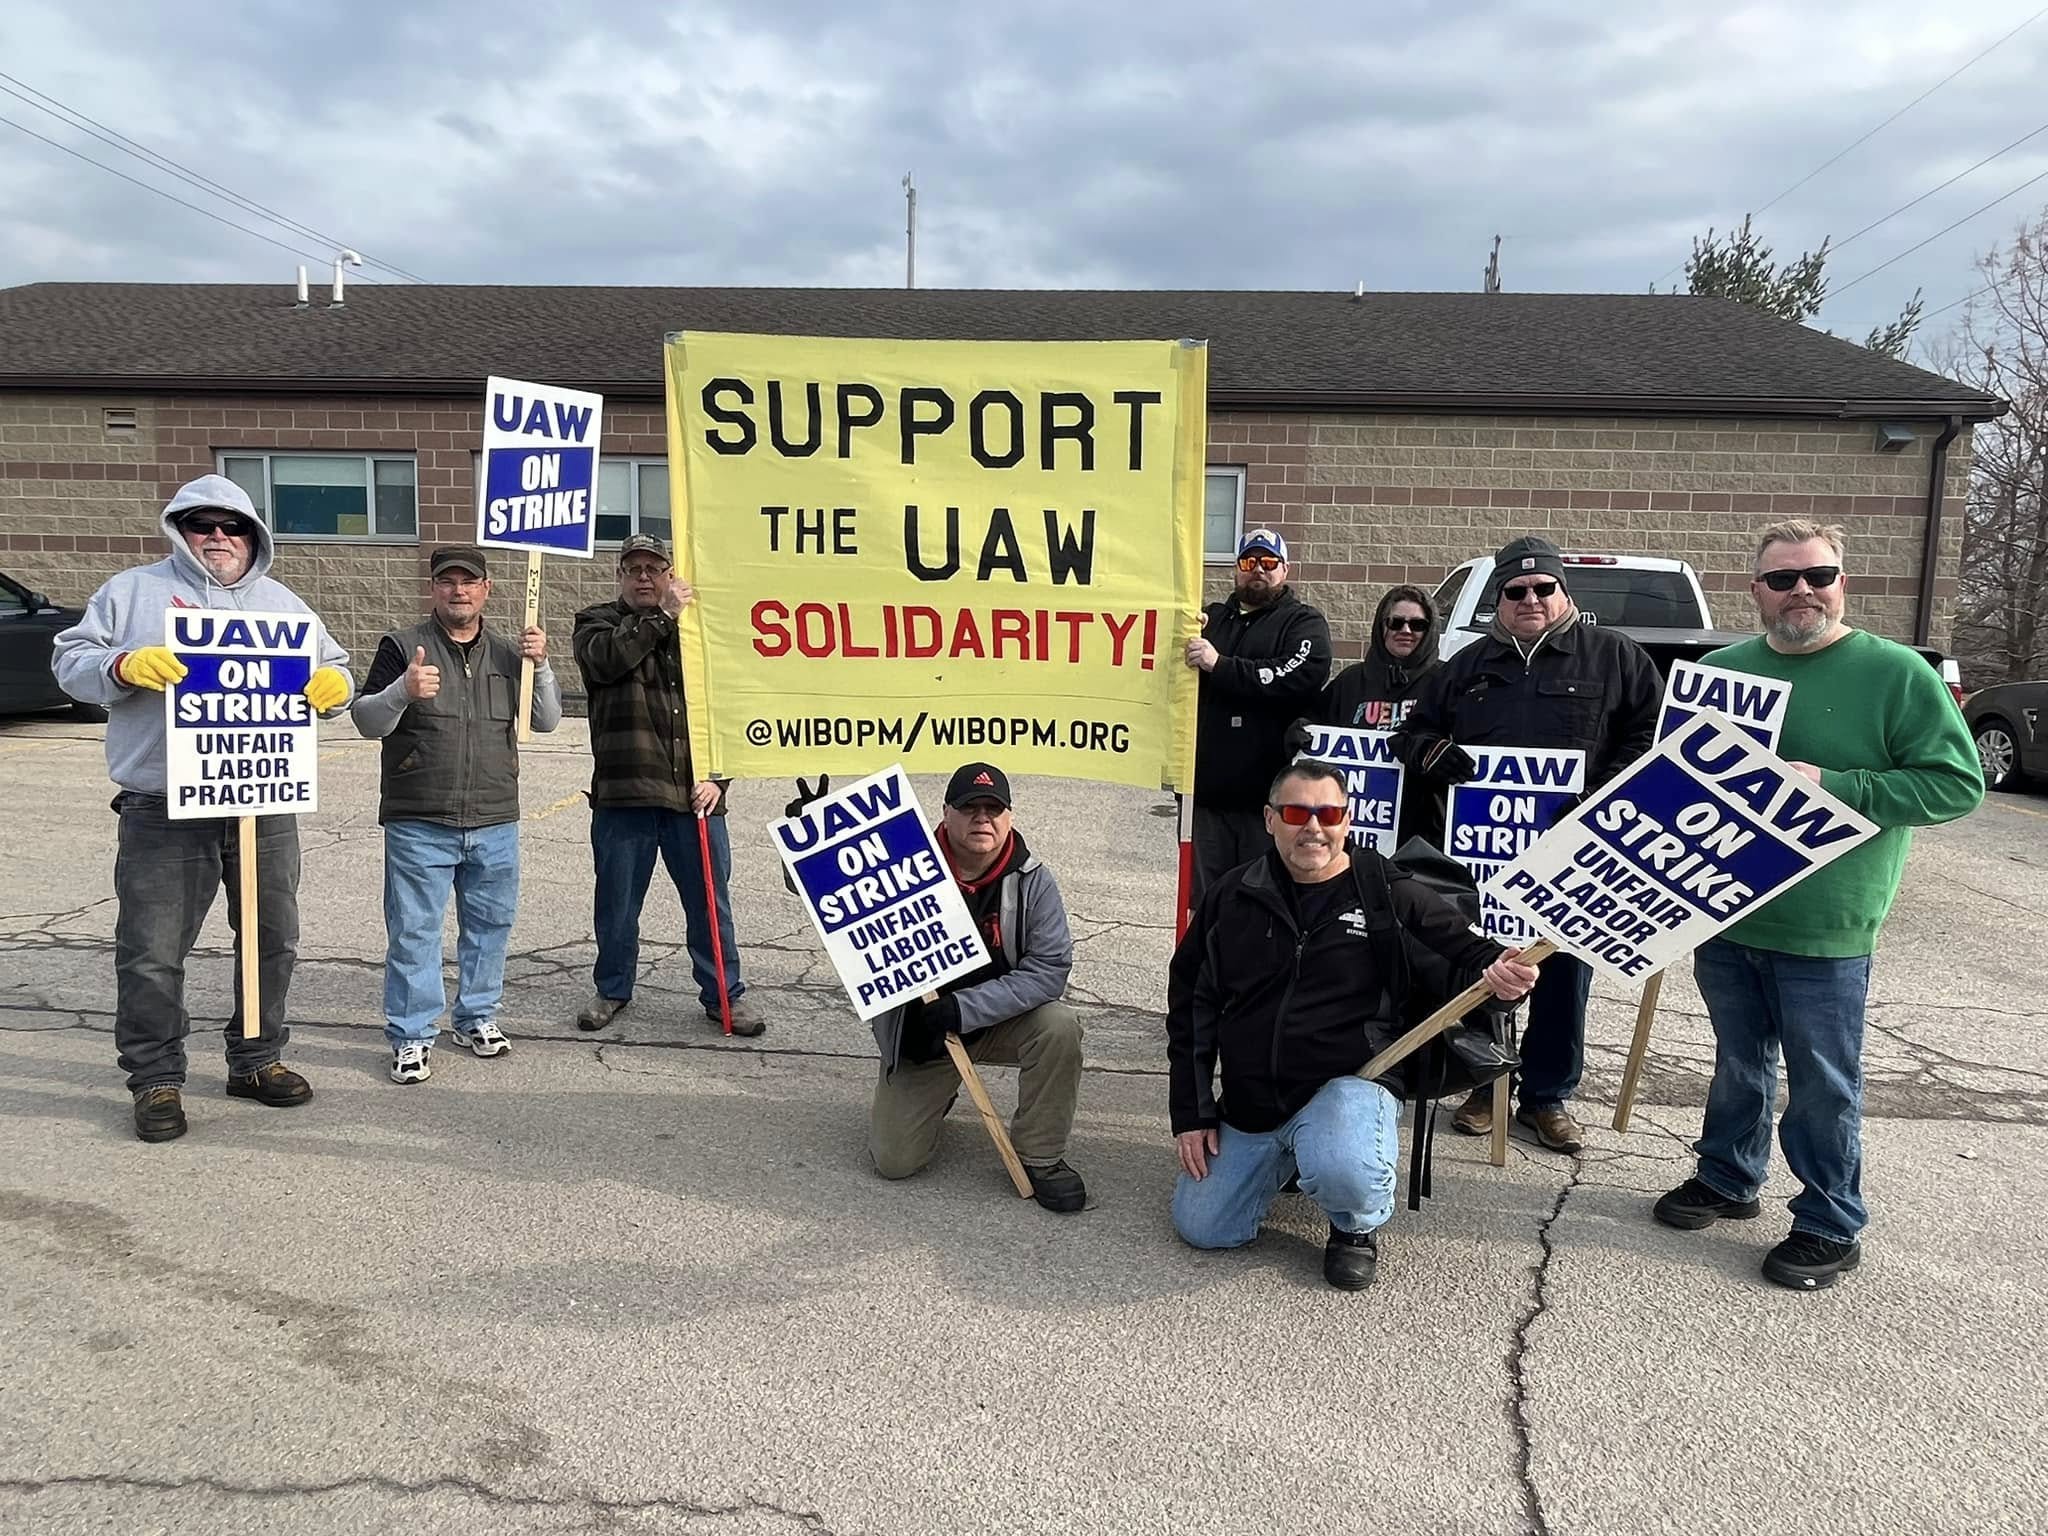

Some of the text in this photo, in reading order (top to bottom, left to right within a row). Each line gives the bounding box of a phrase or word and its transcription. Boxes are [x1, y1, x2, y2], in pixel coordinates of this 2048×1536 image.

[493, 393, 593, 443] UAW
[701, 378, 1161, 470] SUPPORT
[521, 453, 561, 491] ON
[489, 488, 587, 535] STRIKE
[760, 505, 1096, 585] THE UAW
[528, 569, 539, 609] MINE
[175, 616, 310, 649] UAW
[750, 600, 1158, 670] SOLIDARITY!
[218, 660, 270, 689] ON
[1673, 669, 1782, 721] UAW
[178, 692, 307, 722] STRIKE
[196, 733, 294, 755] UNFAIR
[745, 712, 1129, 753] @WIBOPM/WIBOPM.ORG
[179, 781, 310, 806] PRACTICE
[202, 757, 289, 780] LABOR
[1340, 769, 1366, 794] N
[1680, 722, 1863, 850] UAW
[777, 773, 900, 852] UAW
[1350, 798, 1393, 824] IKE
[1489, 794, 1535, 824] ON
[1675, 802, 1756, 859] ON
[837, 831, 890, 877] ON
[1454, 823, 1546, 855] STRI
[1595, 799, 1755, 913] STRIKE
[823, 849, 941, 925] STRIKE
[1548, 866, 1659, 946] LABOR
[1573, 841, 1693, 931] UNFAIR
[848, 893, 943, 951] UNFAIR
[864, 920, 949, 974] LABOR
[1502, 869, 1654, 978] PRACTICE
[857, 934, 980, 1006] PRACTICE
